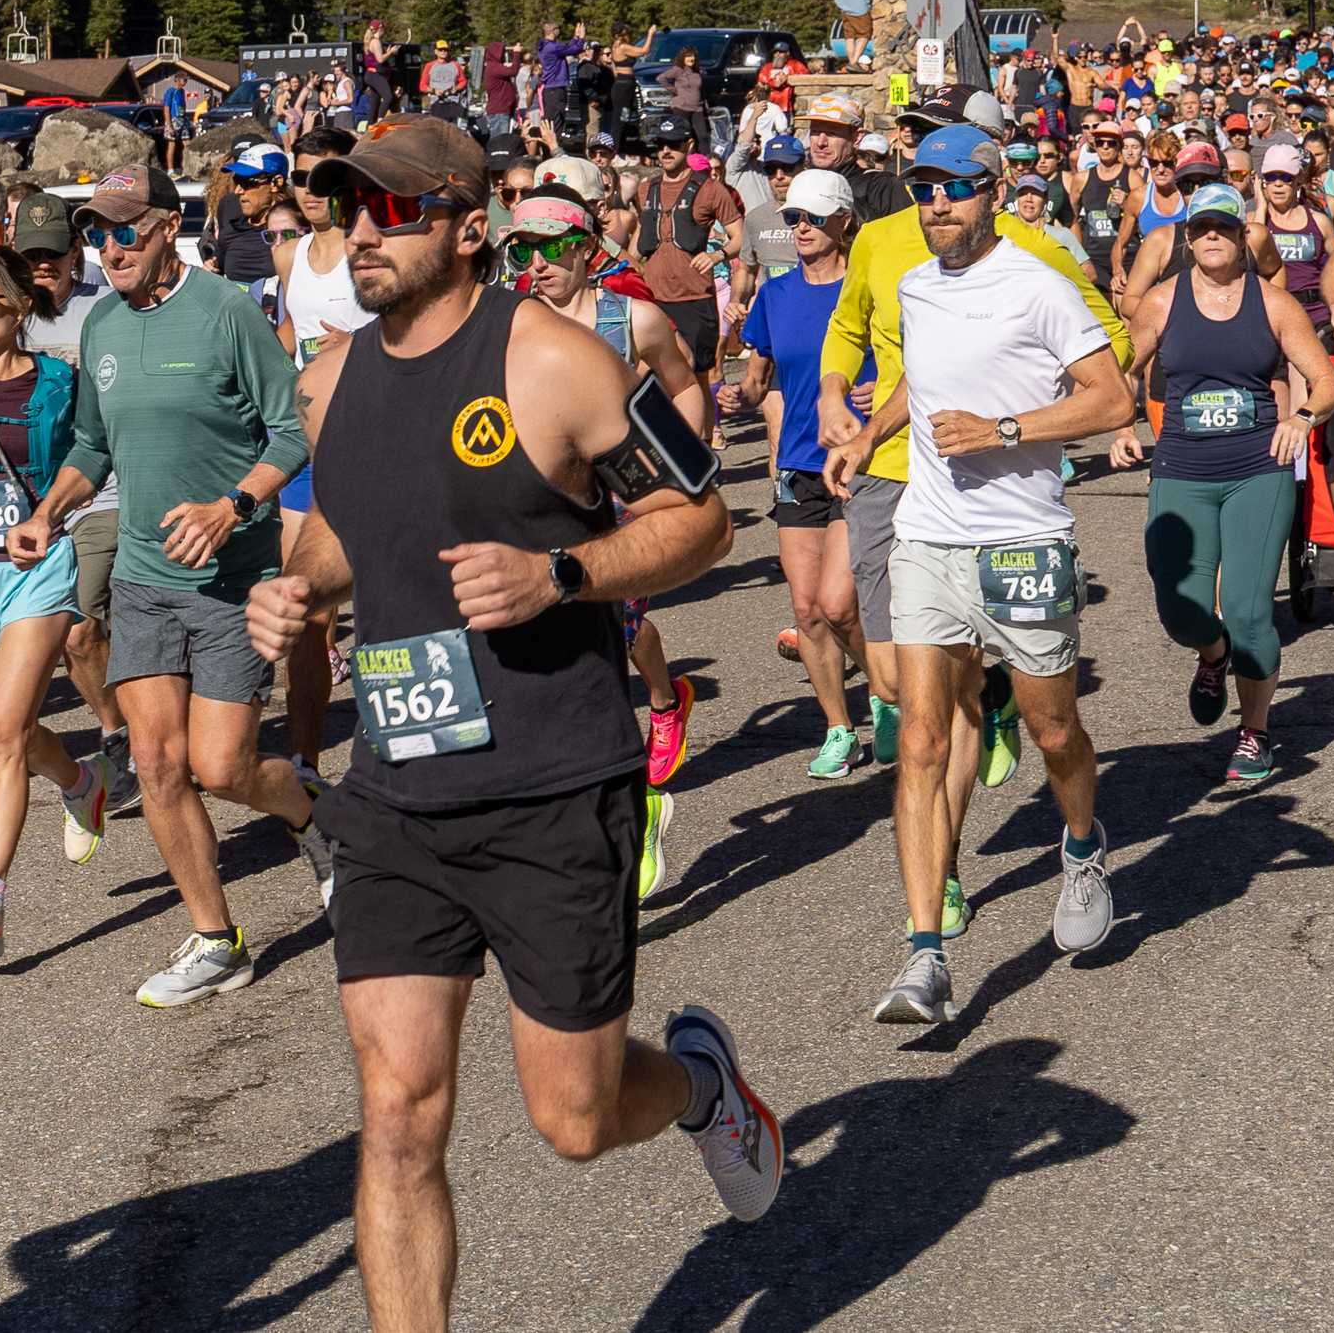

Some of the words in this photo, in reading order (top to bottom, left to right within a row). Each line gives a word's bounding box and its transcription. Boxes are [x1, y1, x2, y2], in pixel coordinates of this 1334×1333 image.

[1199, 408, 1238, 427] 465
[990, 551, 1036, 567] SLACKER
[1002, 573, 1057, 600] 784
[356, 648, 413, 675] SLACKER
[367, 678, 460, 728] 1562
